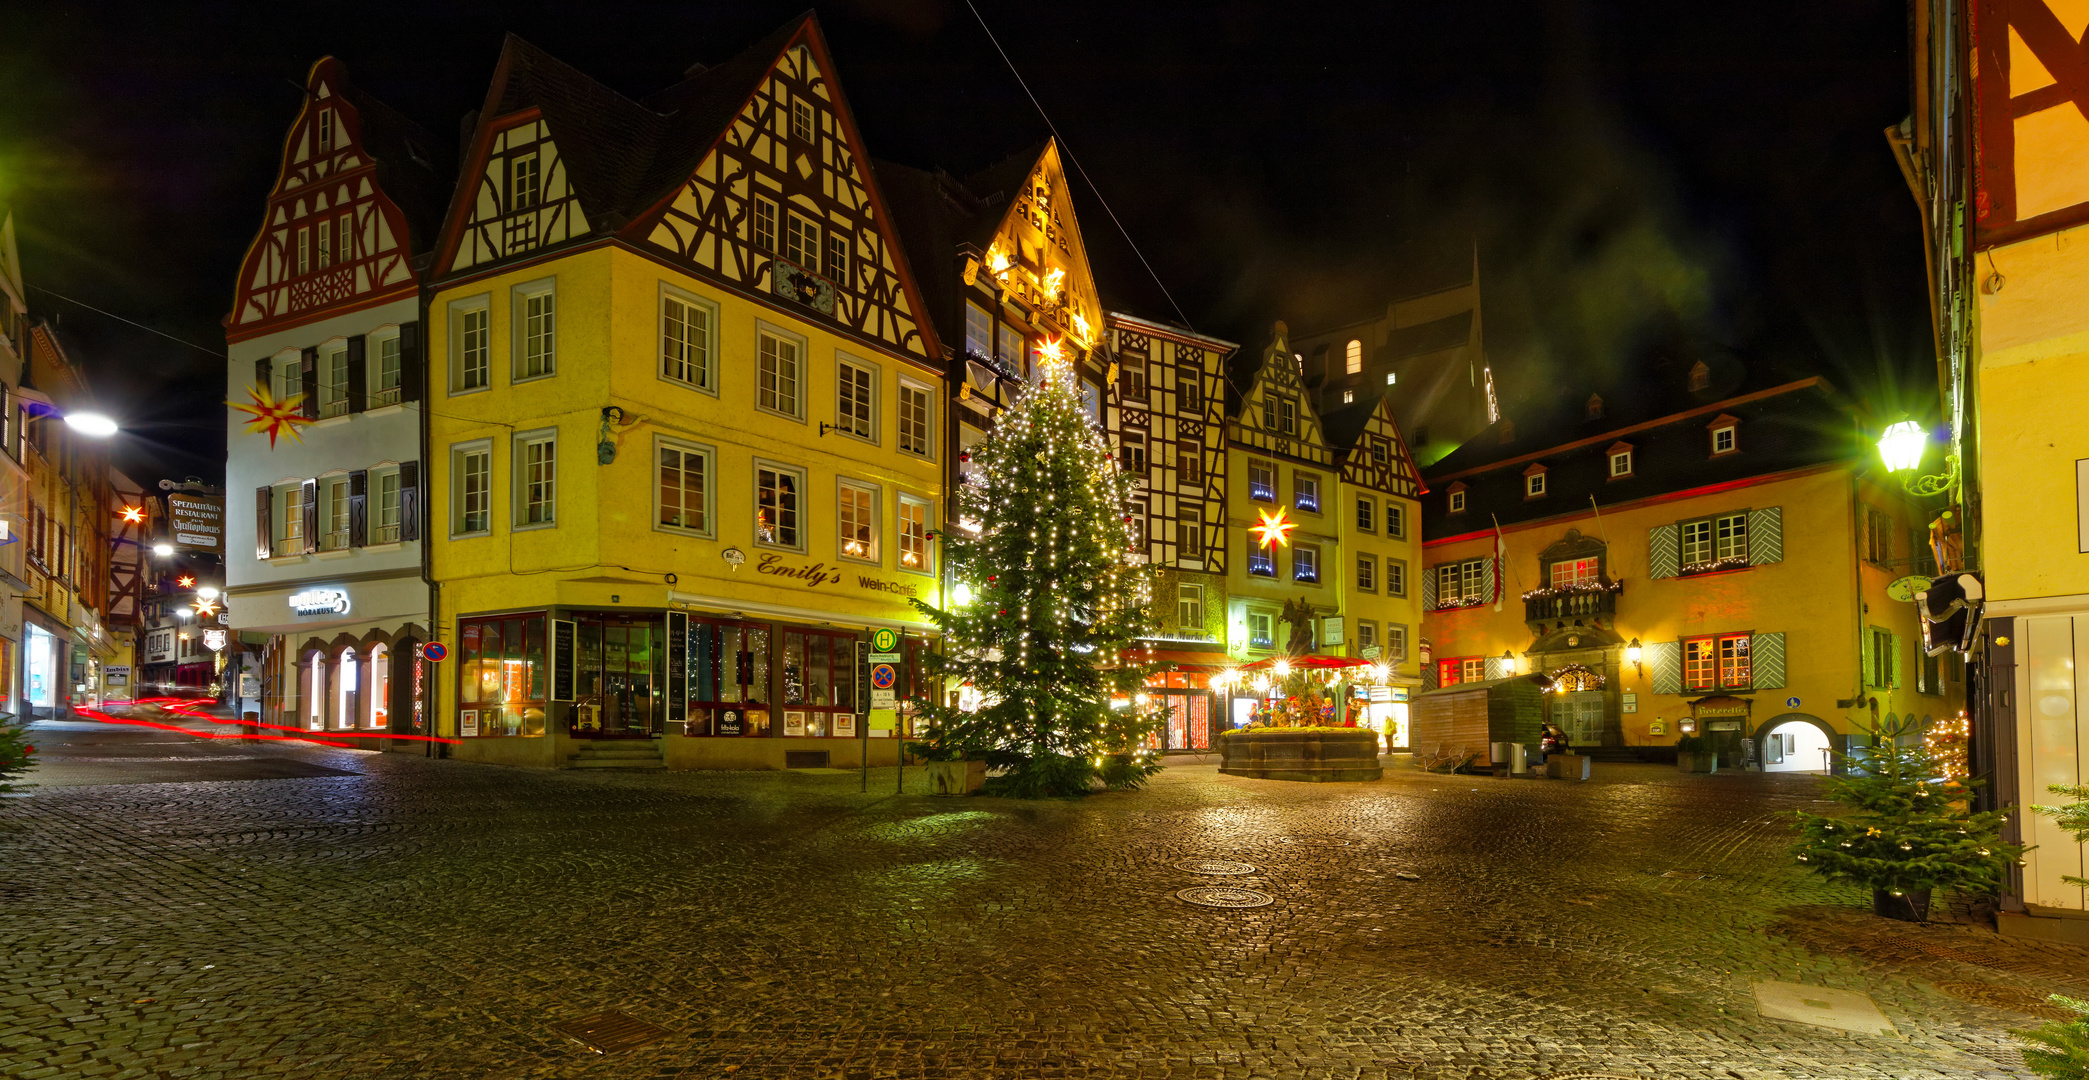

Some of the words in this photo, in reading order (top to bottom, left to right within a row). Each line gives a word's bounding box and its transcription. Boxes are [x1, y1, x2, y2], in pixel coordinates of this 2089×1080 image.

[172, 500, 221, 512] SPEZIALITÄTEN
[175, 509, 218, 520] RESTAURANT
[858, 575, 917, 597] Wein-Café
[880, 633, 890, 647] H
[1177, 631, 1203, 641] Markt
